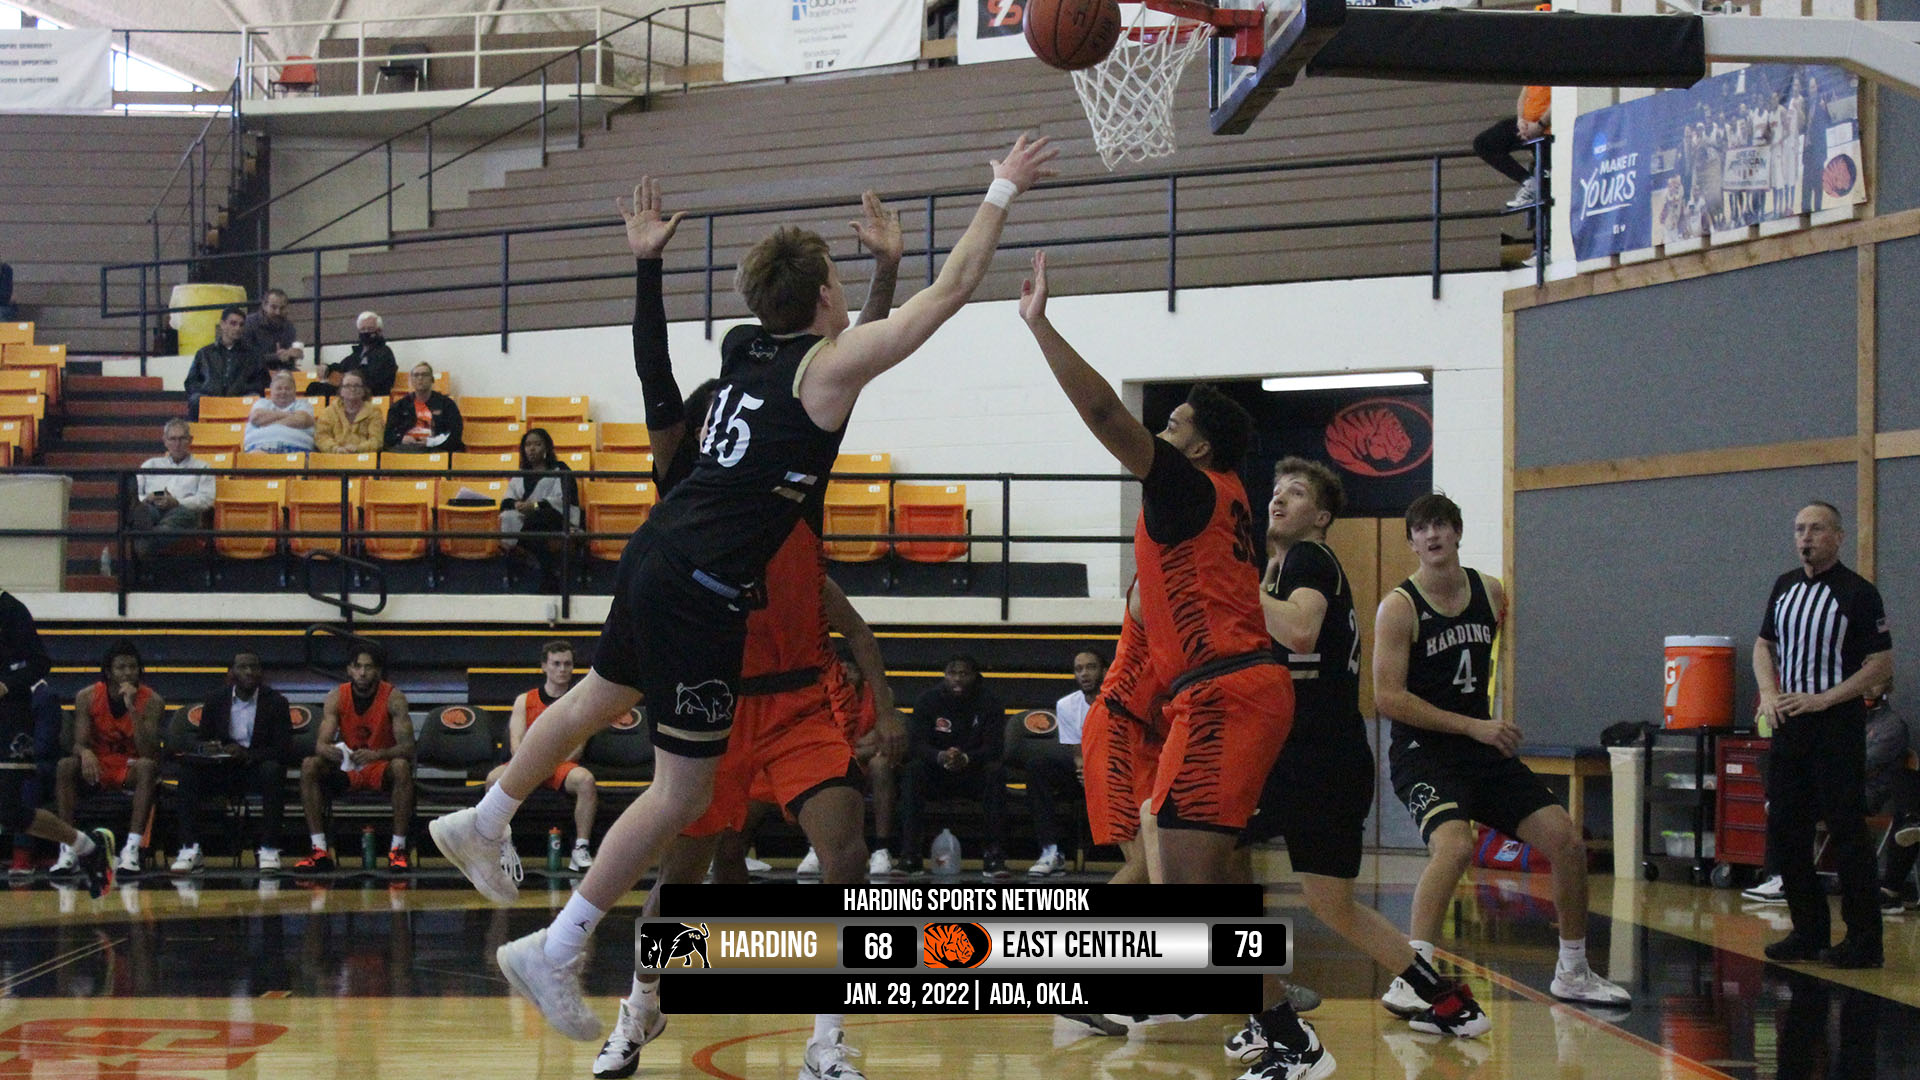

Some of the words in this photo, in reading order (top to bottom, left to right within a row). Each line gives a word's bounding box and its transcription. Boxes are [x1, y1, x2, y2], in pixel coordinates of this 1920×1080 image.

[1600, 156, 1627, 175] MAKE
[1628, 152, 1638, 168] IT
[1580, 168, 1637, 220] YOURS
[1426, 623, 1491, 657] HARDING
[1452, 648, 1477, 694] 4
